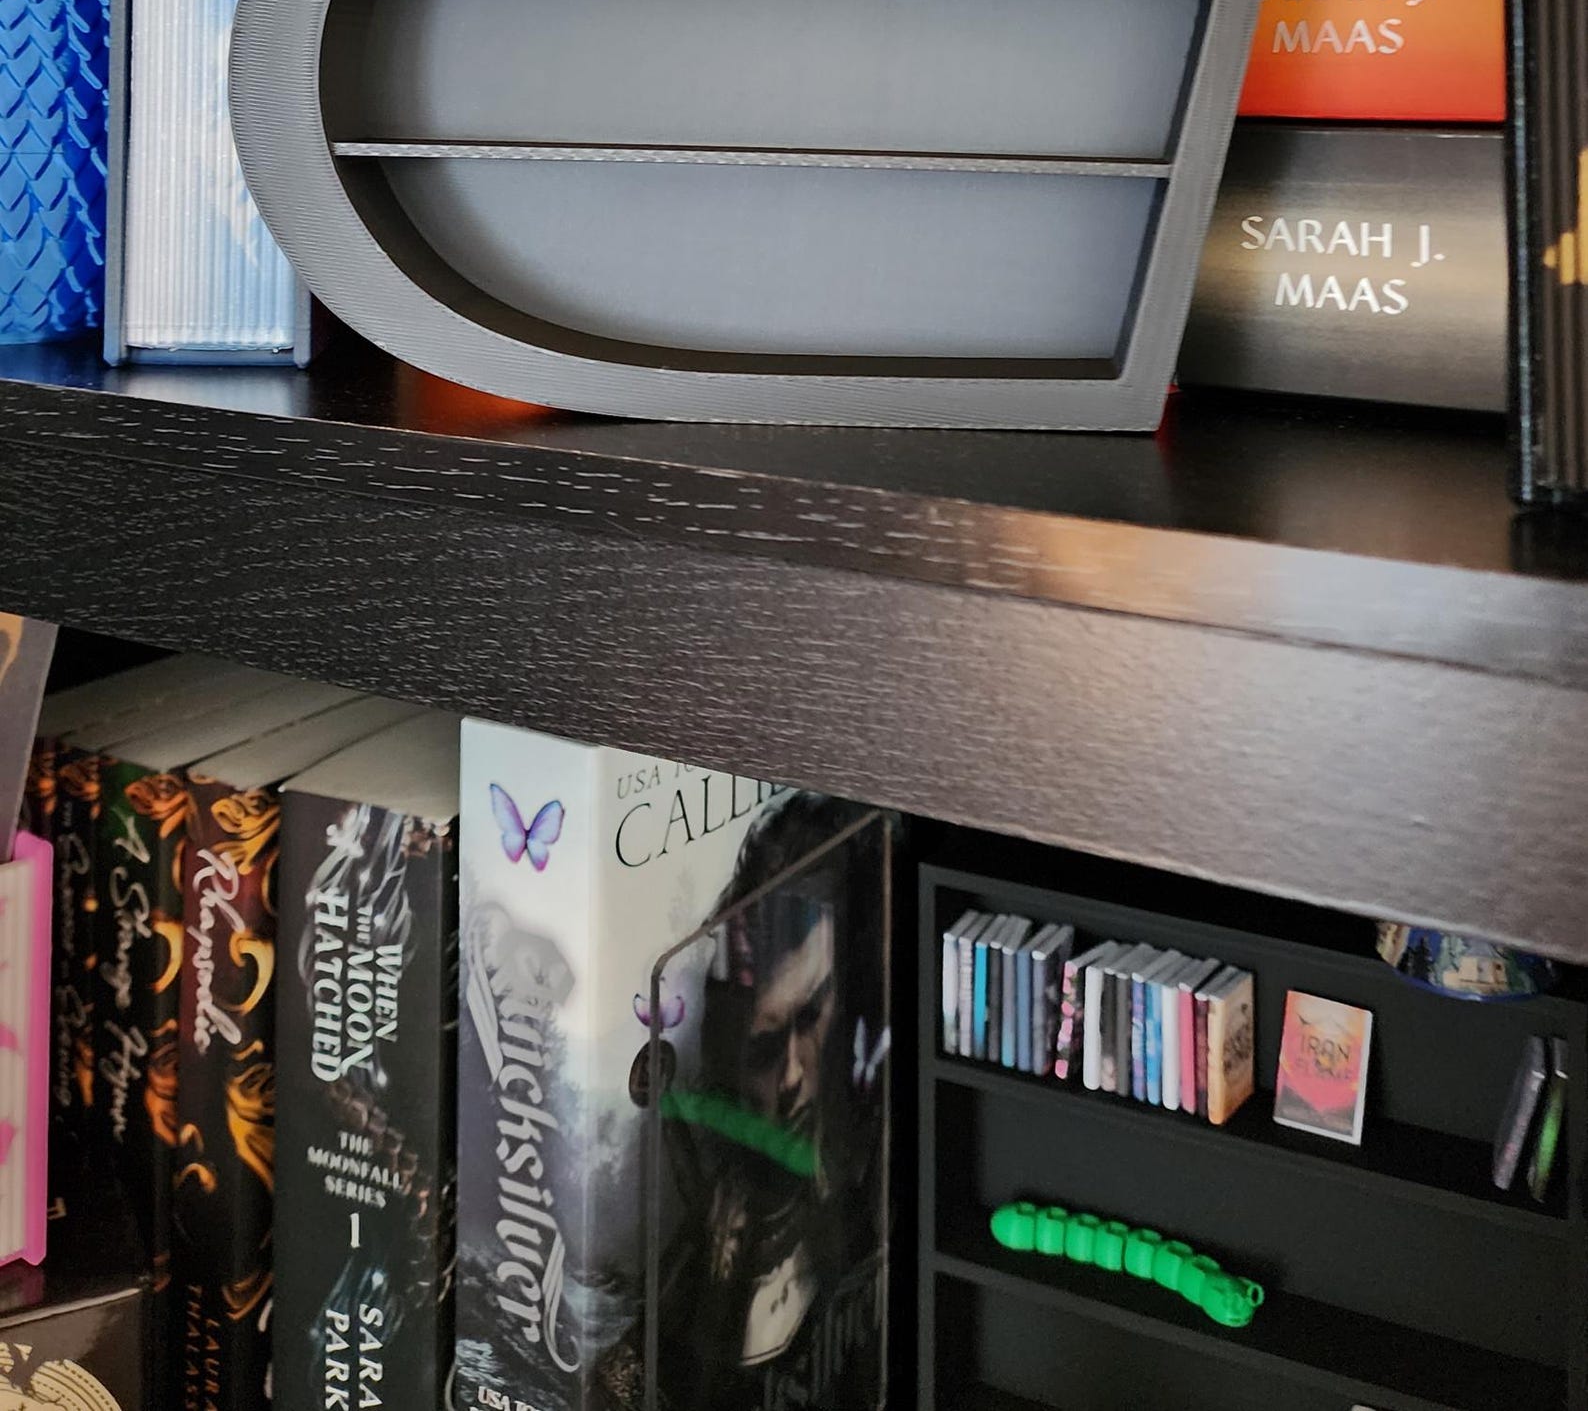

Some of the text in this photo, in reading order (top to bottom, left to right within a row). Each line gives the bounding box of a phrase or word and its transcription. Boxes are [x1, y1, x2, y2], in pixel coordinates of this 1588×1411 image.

[1272, 18, 1405, 54] MAAS
[1240, 215, 1445, 268] SARAH J.
[1274, 272, 1409, 316] MAAS
[617, 765, 661, 800] USA
[312, 886, 350, 1082] HATCHED
[375, 943, 403, 1042] WHEN
[341, 944, 375, 1078] MOON
[339, 1131, 372, 1156] THE
[324, 1175, 386, 1209] SERIES
[358, 1303, 384, 1409] SARA
